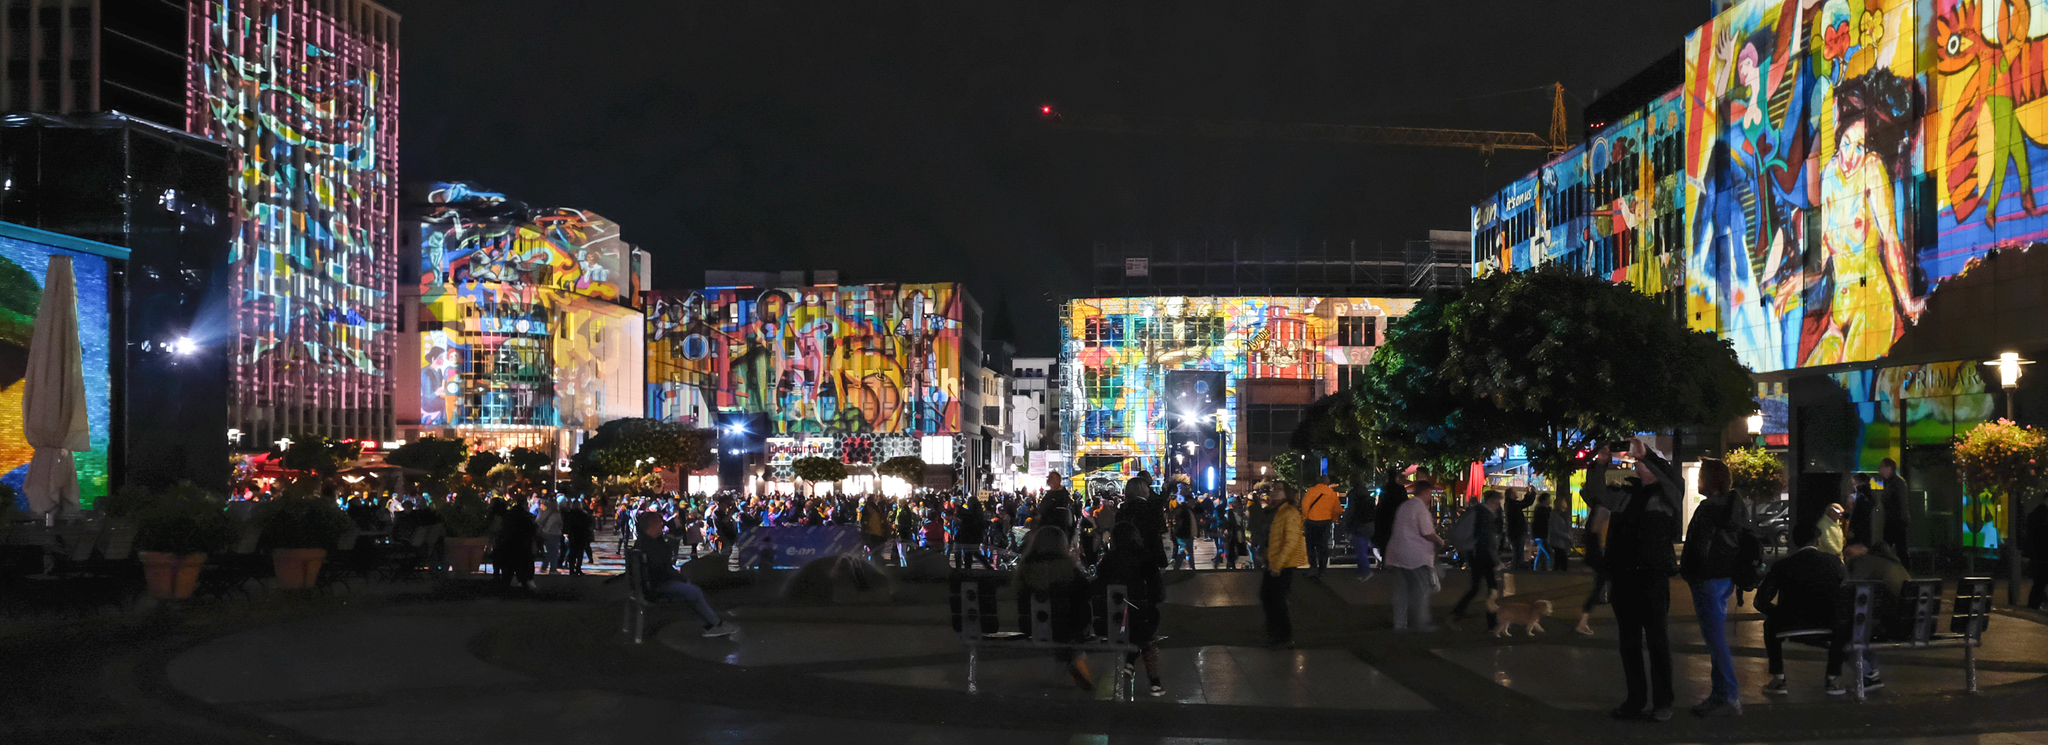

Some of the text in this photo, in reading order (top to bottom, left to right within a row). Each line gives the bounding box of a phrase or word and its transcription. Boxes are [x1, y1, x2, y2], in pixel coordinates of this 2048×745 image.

[1506, 189, 1532, 212] it's on us
[1902, 366, 1985, 390] PRIMAR
